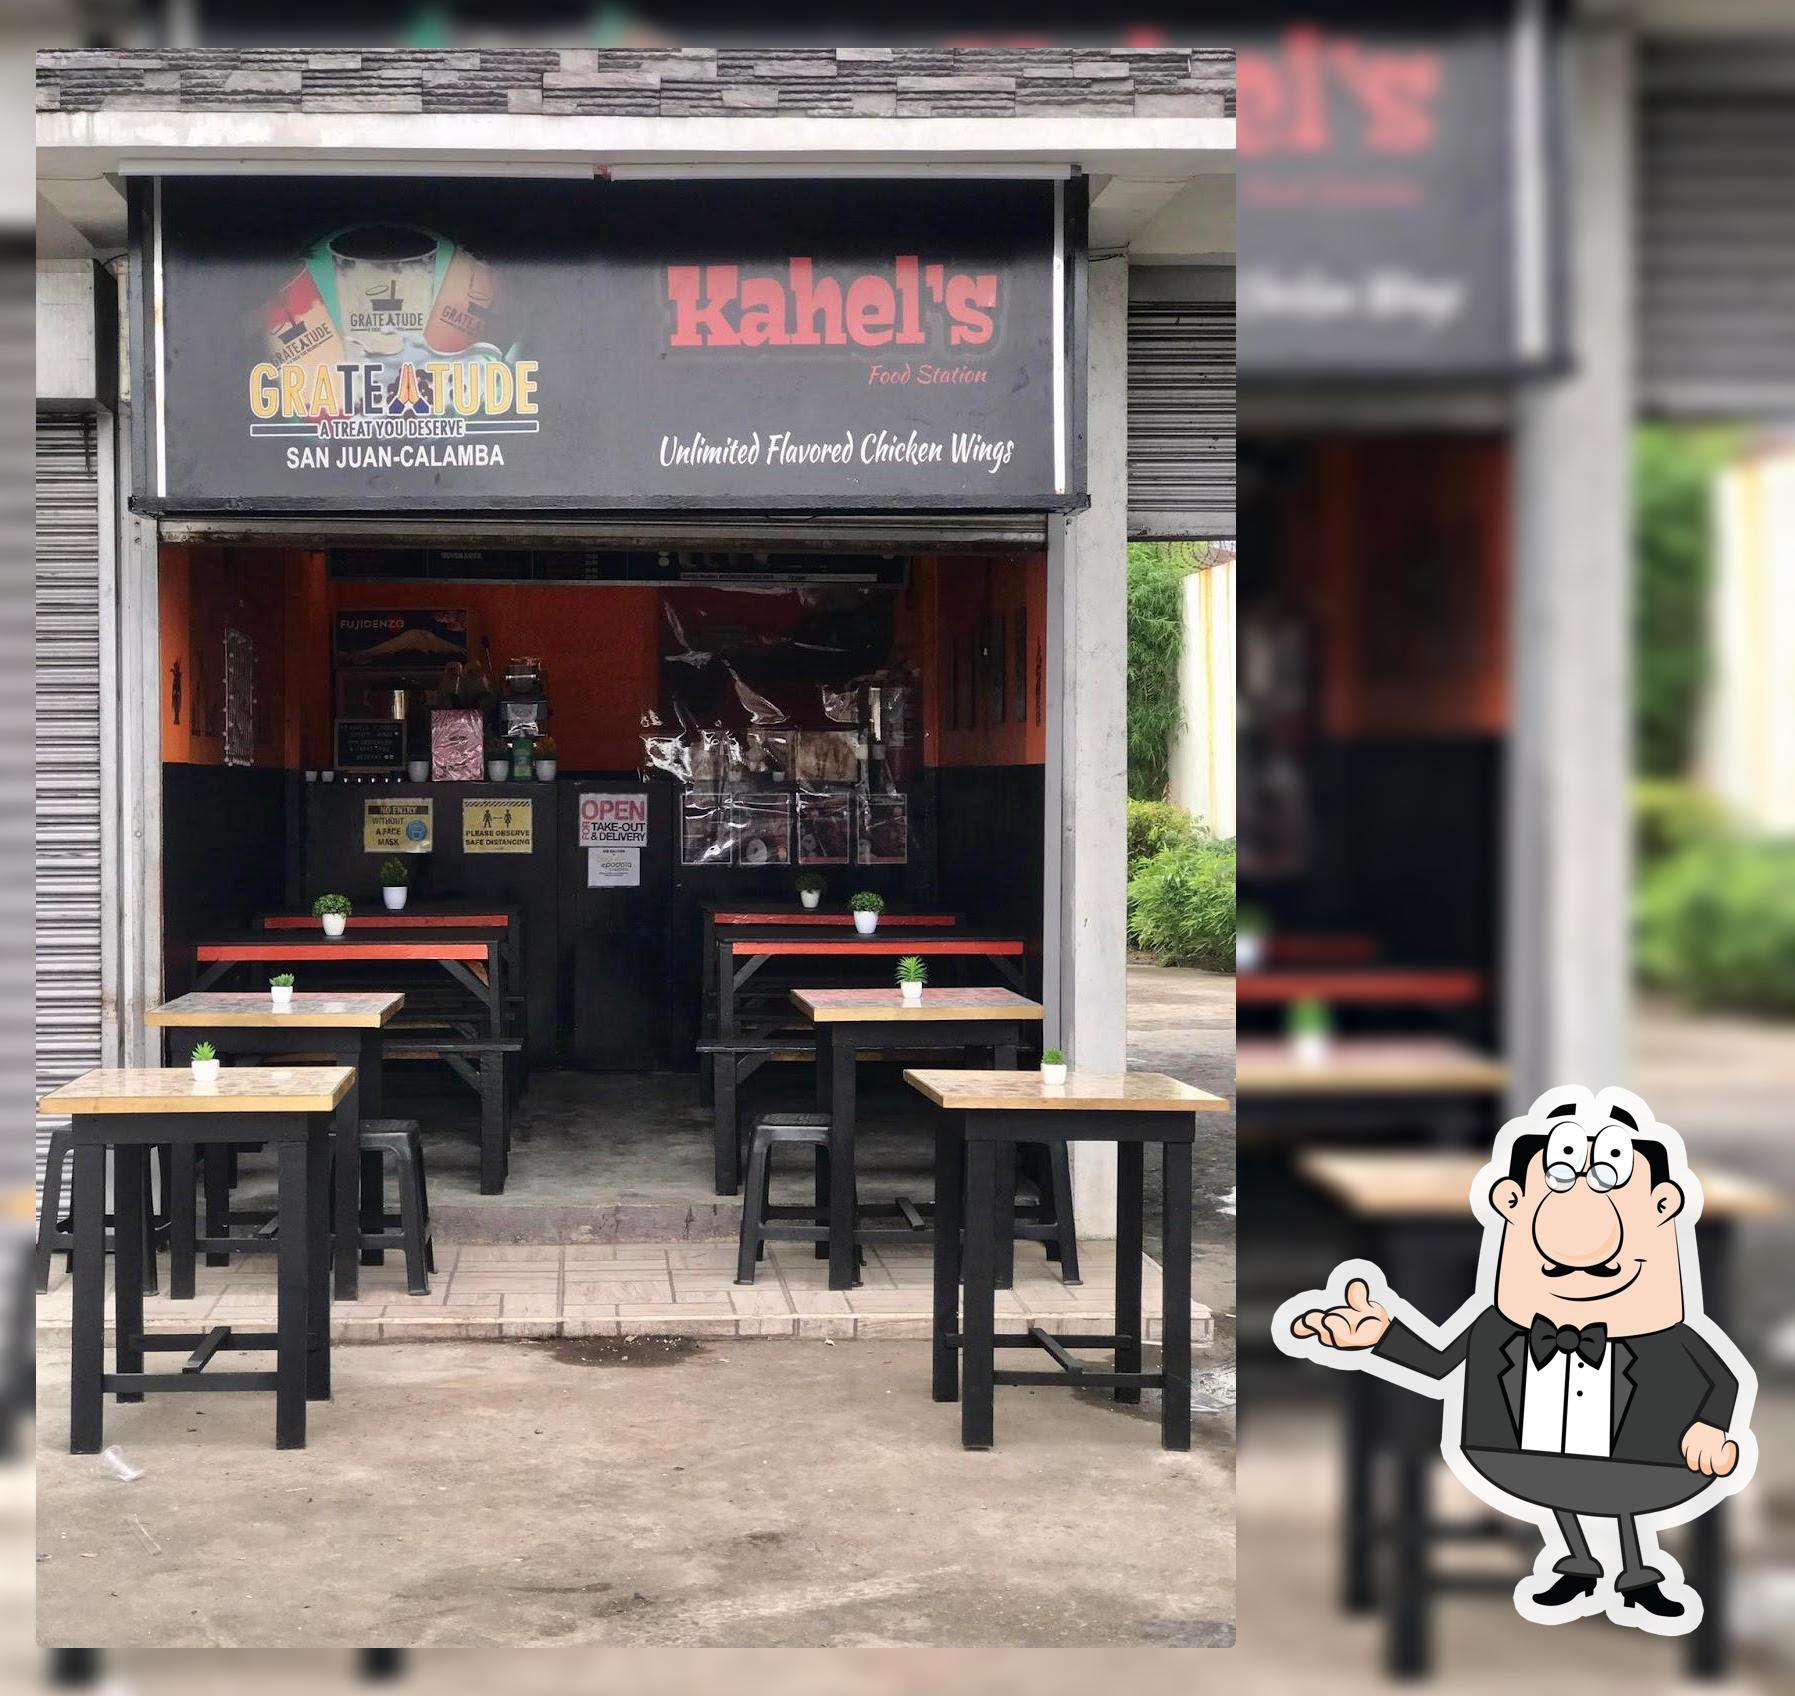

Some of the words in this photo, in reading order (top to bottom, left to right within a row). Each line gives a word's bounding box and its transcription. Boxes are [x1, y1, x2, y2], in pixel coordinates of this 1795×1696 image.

[667, 255, 998, 347] Kahel's
[868, 362, 911, 385] Food
[916, 363, 988, 385] Station
[319, 421, 331, 438] A
[333, 420, 373, 437] TREAT
[374, 420, 403, 437] YOU
[408, 419, 464, 437] DESERVE
[286, 446, 332, 469] SAN
[335, 444, 505, 468] JUAN-CALAMBA
[659, 431, 760, 467] Unlimited
[766, 430, 854, 466] Flavored
[860, 429, 943, 466] Chicken
[951, 432, 1015, 474] Wings
[340, 619, 405, 630] FUJIDENZO
[581, 799, 645, 821] OPEN
[372, 816, 404, 825] WITHOUT
[591, 822, 646, 832] TAKE-OUT
[383, 828, 402, 836] FACE
[582, 821, 590, 841] FOR
[591, 832, 598, 841] &
[599, 832, 646, 841] DELIVERY
[378, 838, 400, 847] MASK
